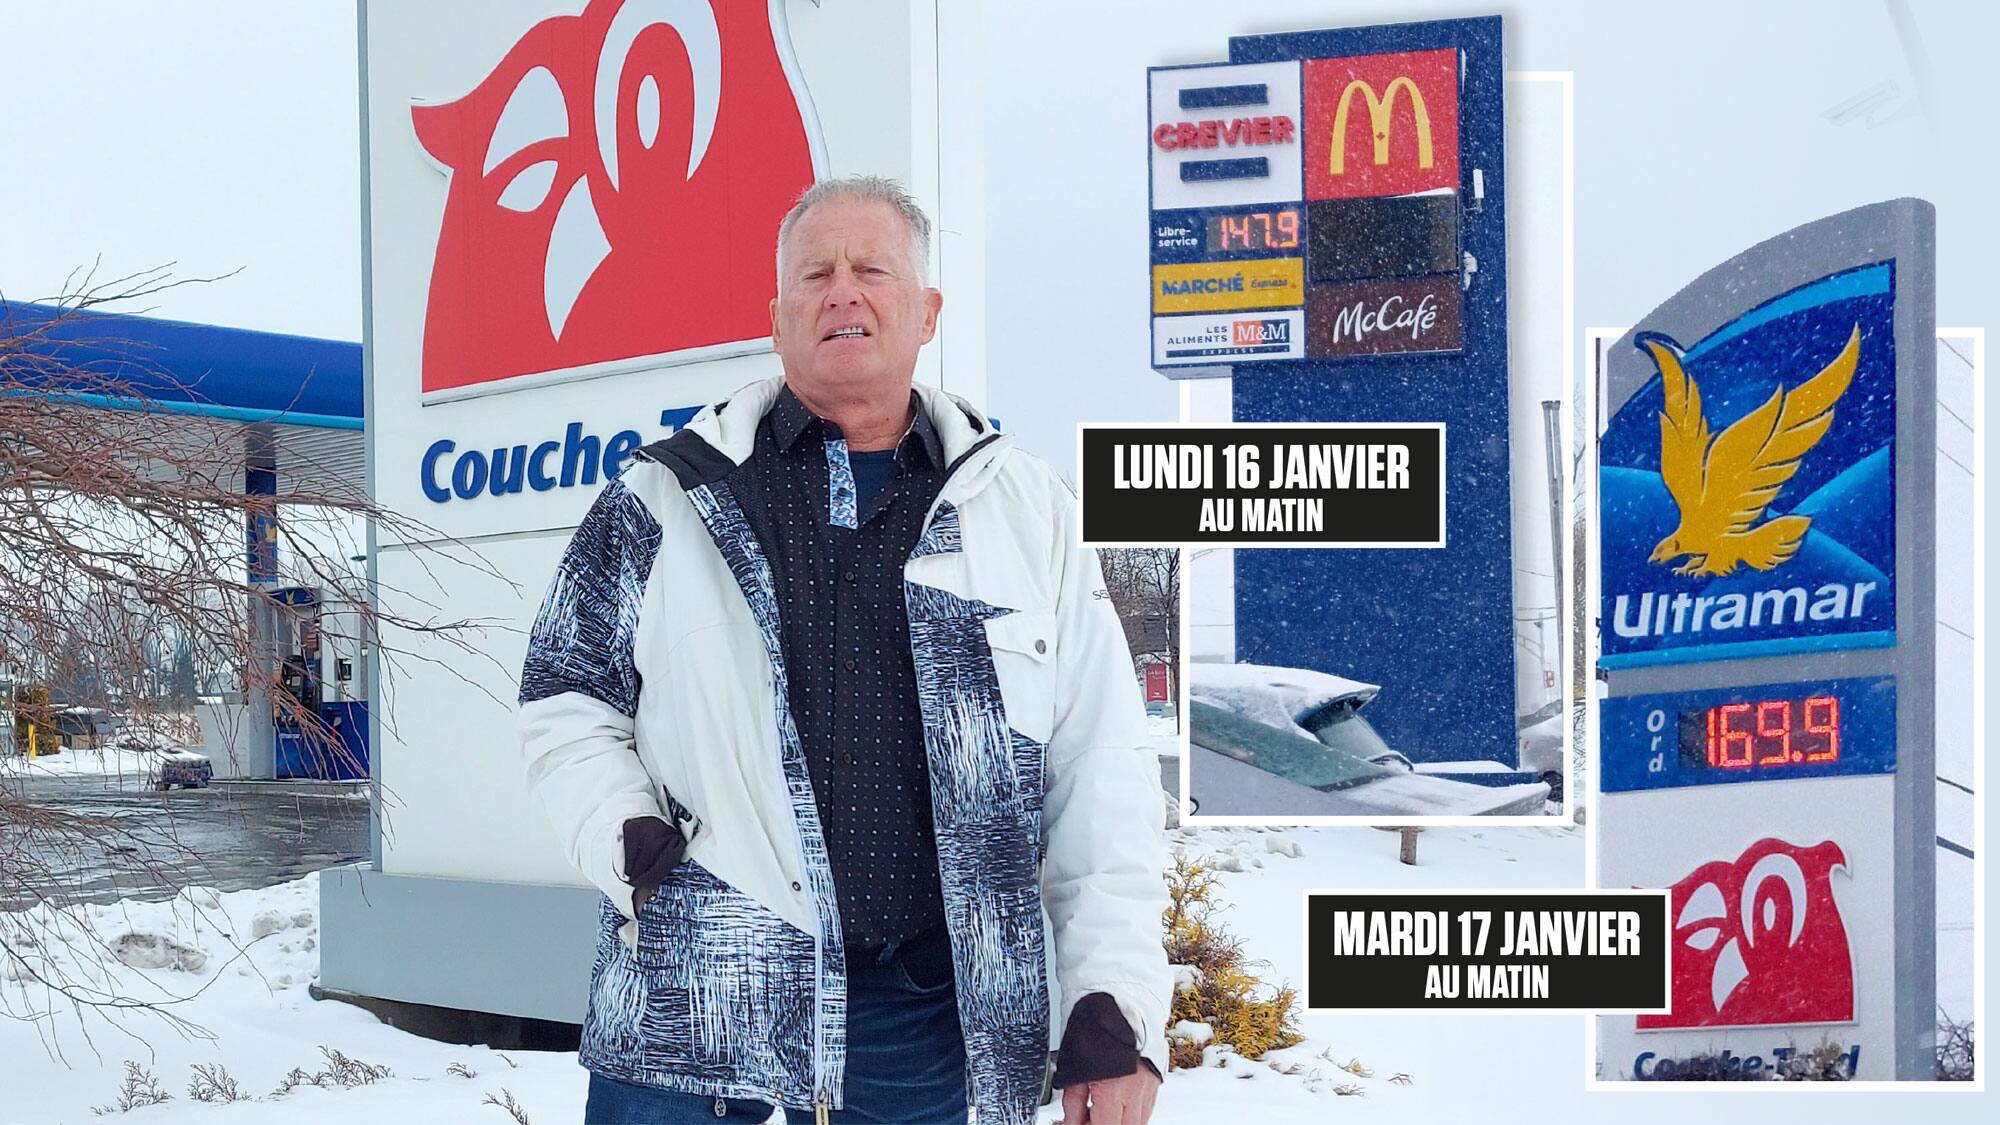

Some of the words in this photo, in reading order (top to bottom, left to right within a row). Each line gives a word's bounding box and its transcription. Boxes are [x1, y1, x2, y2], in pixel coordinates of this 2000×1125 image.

[1153, 115, 1295, 151] CREVIER
[1158, 227, 1191, 237] Libre-
[1158, 236, 1198, 247] service
[1220, 211, 1299, 250] 147.9
[1162, 271, 1244, 296] MARCHÉ
[1167, 335, 1228, 345] ALIMENTS
[1237, 322, 1287, 343] M&M
[1206, 325, 1228, 334] LES
[1332, 294, 1436, 343] McCafé
[1613, 581, 1876, 637] Ultramar
[1706, 695, 1839, 768] 169.9
